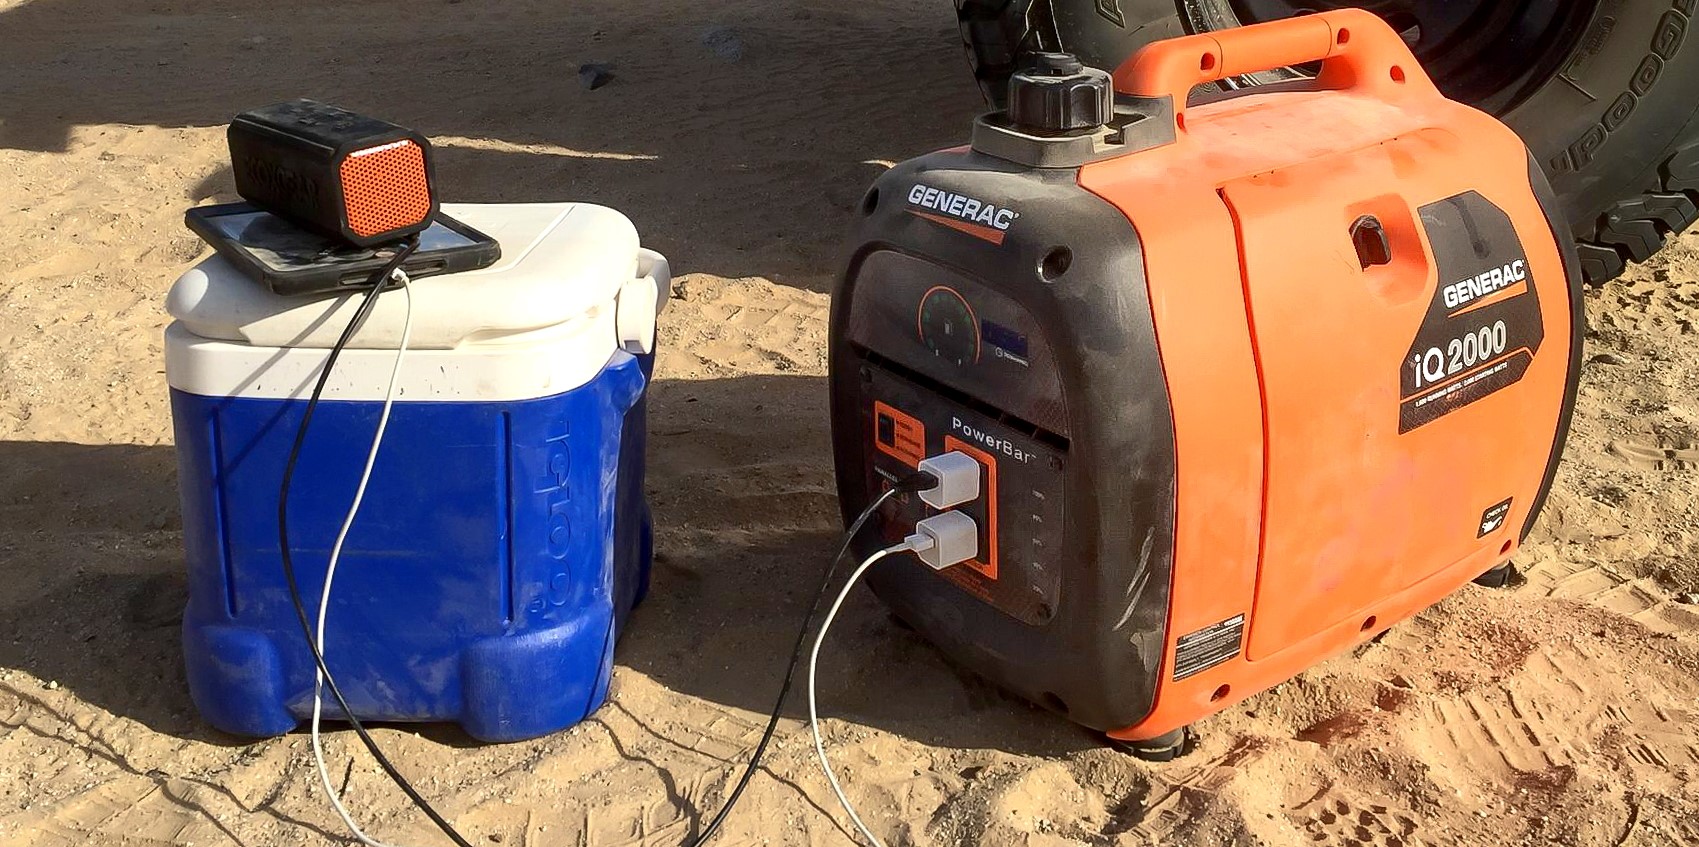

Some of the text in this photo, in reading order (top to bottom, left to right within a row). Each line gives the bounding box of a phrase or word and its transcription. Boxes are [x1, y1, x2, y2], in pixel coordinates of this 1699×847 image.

[908, 184, 1013, 230] GENERAC
[1444, 260, 1525, 308] GENERAC
[951, 415, 1031, 465] PowerBar
[533, 419, 572, 607] IGLOO
